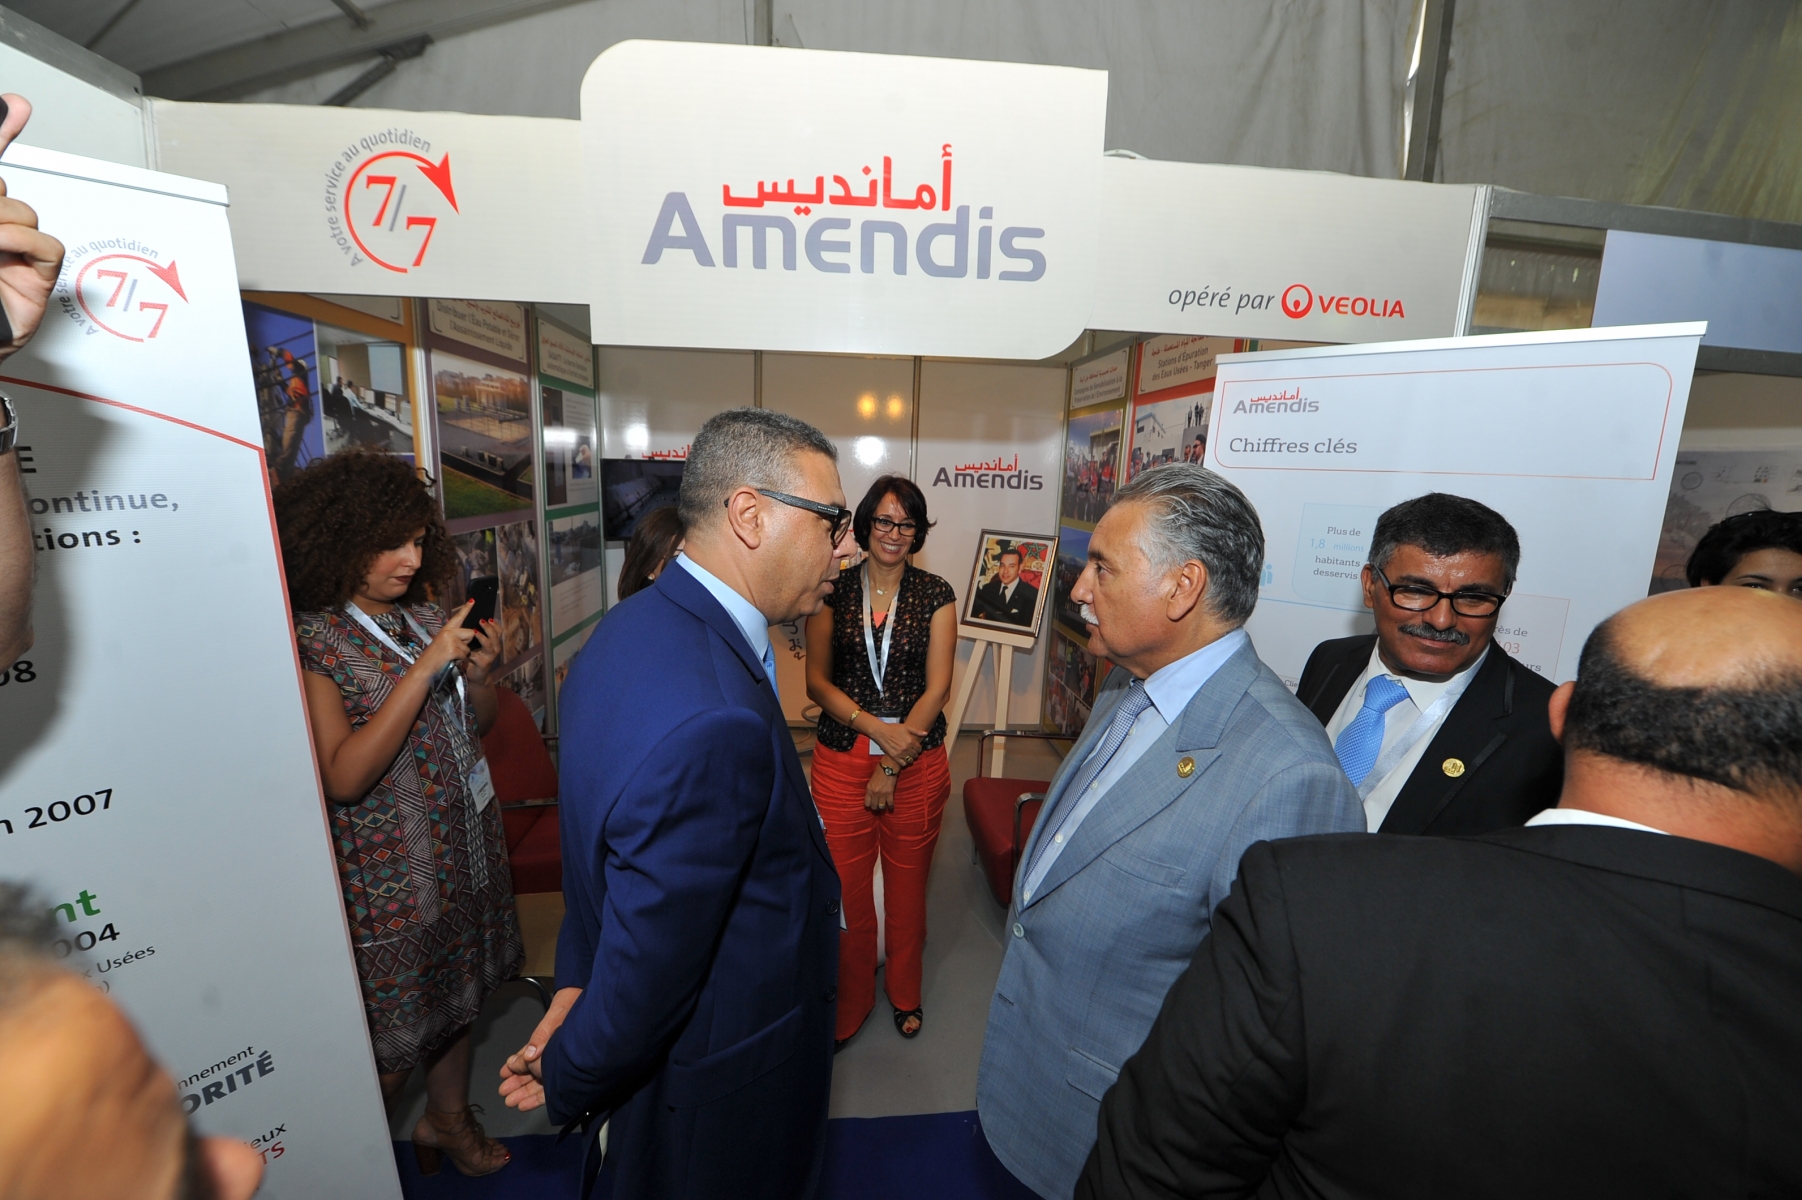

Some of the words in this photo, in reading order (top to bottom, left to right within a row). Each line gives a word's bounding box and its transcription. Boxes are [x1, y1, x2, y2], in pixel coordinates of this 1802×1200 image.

[360, 127, 431, 153] quotidien
[341, 144, 360, 163] au
[325, 160, 346, 212] service
[722, 143, 953, 216] أمانديس
[327, 215, 353, 255] votre
[641, 192, 1047, 282] Amendis
[70, 245, 89, 258] au
[89, 238, 159, 259] quotidien
[350, 253, 364, 267] A
[59, 296, 86, 327] votre
[1168, 285, 1232, 312] opéré
[1235, 292, 1275, 315] par
[1318, 295, 1405, 318] VEOLIA
[85, 325, 99, 336] A
[1152, 372, 1160, 381] des
[1161, 369, 1172, 379] Eaux
[1173, 364, 1189, 376] Usées
[1193, 358, 1213, 371] Tanger
[1158, 356, 1176, 369] Stations
[1232, 397, 1320, 414] Amendis
[1229, 437, 1309, 453] Chiffres
[1314, 438, 1358, 454] clés
[955, 453, 1018, 473] أمانديس
[932, 467, 1043, 490] Amendis
[29, 490, 179, 515] ontinue,
[1327, 526, 1348, 536] Plus
[1349, 528, 1361, 536] de
[1311, 538, 1326, 550] 1,8
[1333, 543, 1365, 553] millions
[1315, 555, 1361, 567] habitants
[1313, 568, 1358, 580] desservis
[1513, 627, 1528, 637] de
[1285, 679, 1299, 688] Clie
[24, 788, 113, 829] 2007
[53, 923, 120, 959] 004
[97, 946, 155, 973] Usées
[177, 1046, 255, 1091] nnement
[179, 1050, 275, 1116] ORITÉ
[250, 1123, 287, 1149] eux
